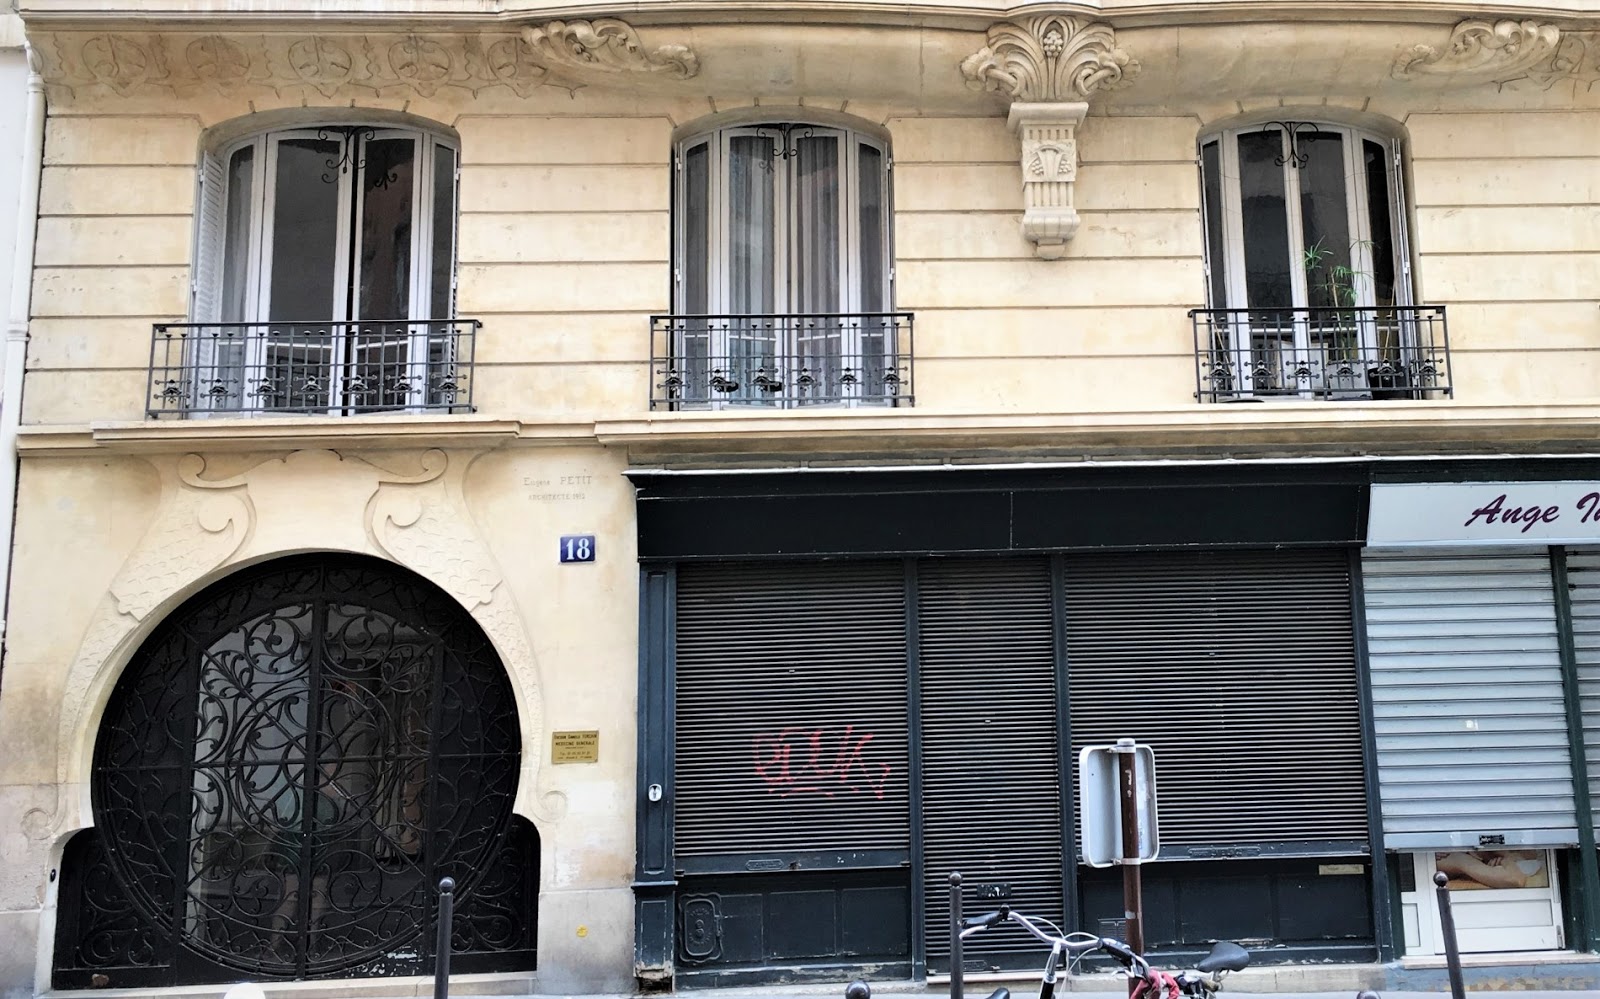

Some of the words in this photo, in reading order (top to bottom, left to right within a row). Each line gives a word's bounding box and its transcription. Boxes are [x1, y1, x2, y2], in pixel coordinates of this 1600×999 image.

[560, 475, 593, 485] PETIT
[1464, 494, 1560, 533] Ange
[566, 538, 590, 560] 18
